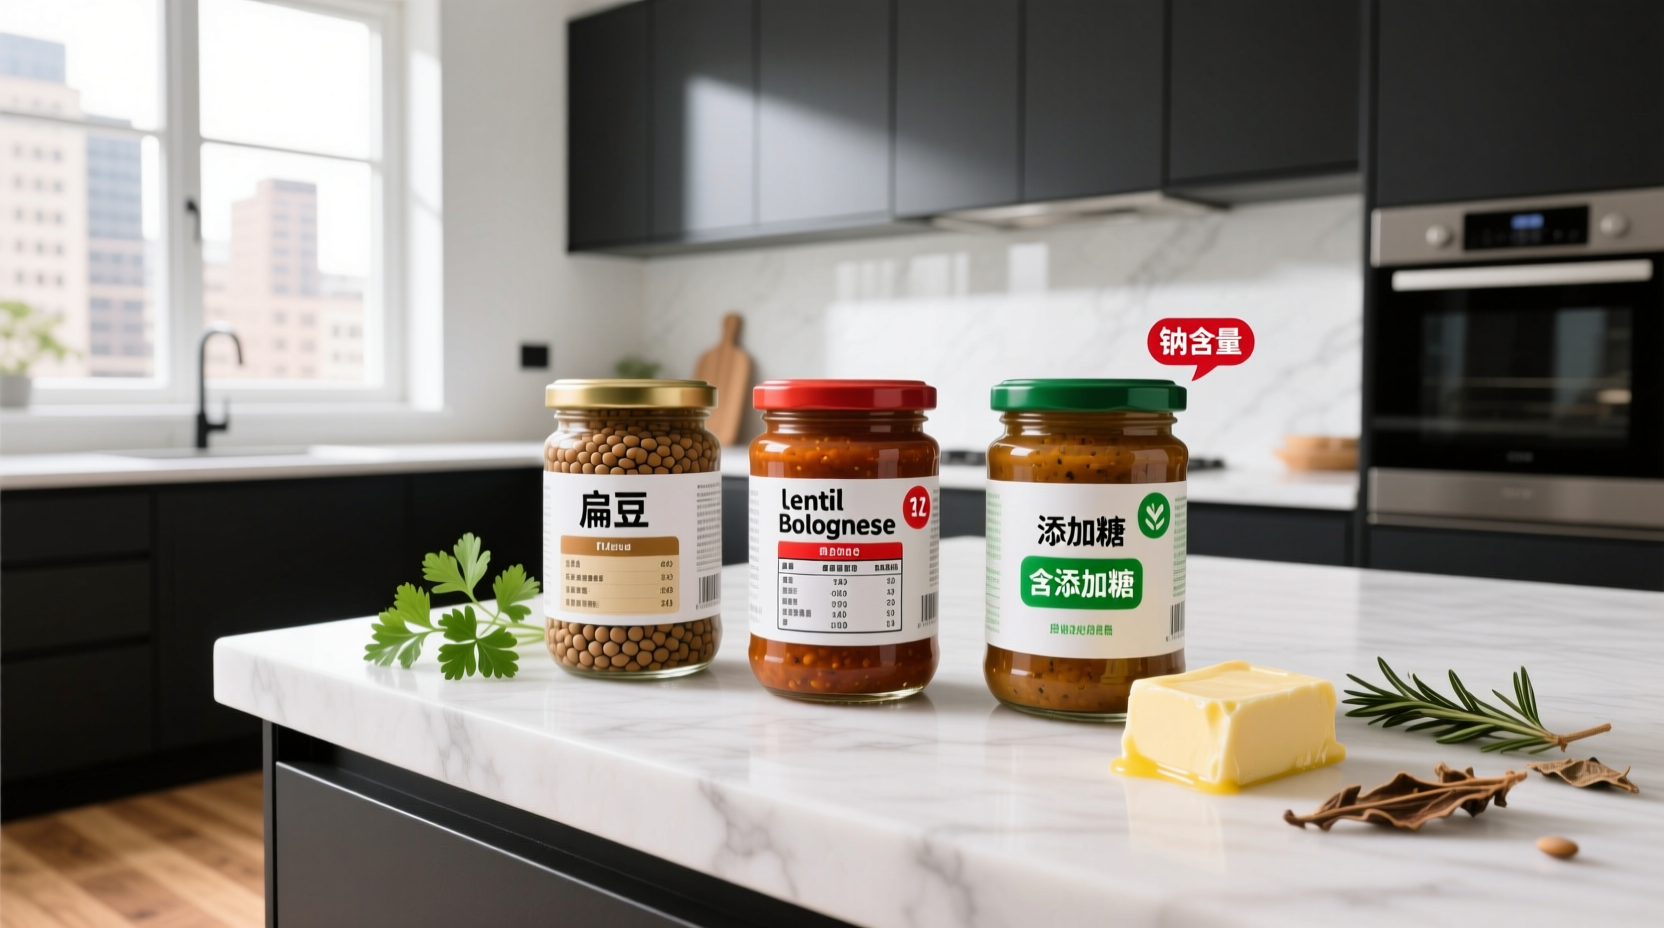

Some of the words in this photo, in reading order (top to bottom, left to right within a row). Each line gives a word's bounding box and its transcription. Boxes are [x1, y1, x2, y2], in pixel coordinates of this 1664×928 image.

[579, 490, 649, 529] 扁豆
[781, 488, 844, 511] Lentil
[779, 513, 896, 541] Bolognese
[1037, 515, 1126, 547] 添加糖
[1029, 567, 1135, 599] 含添加糖
